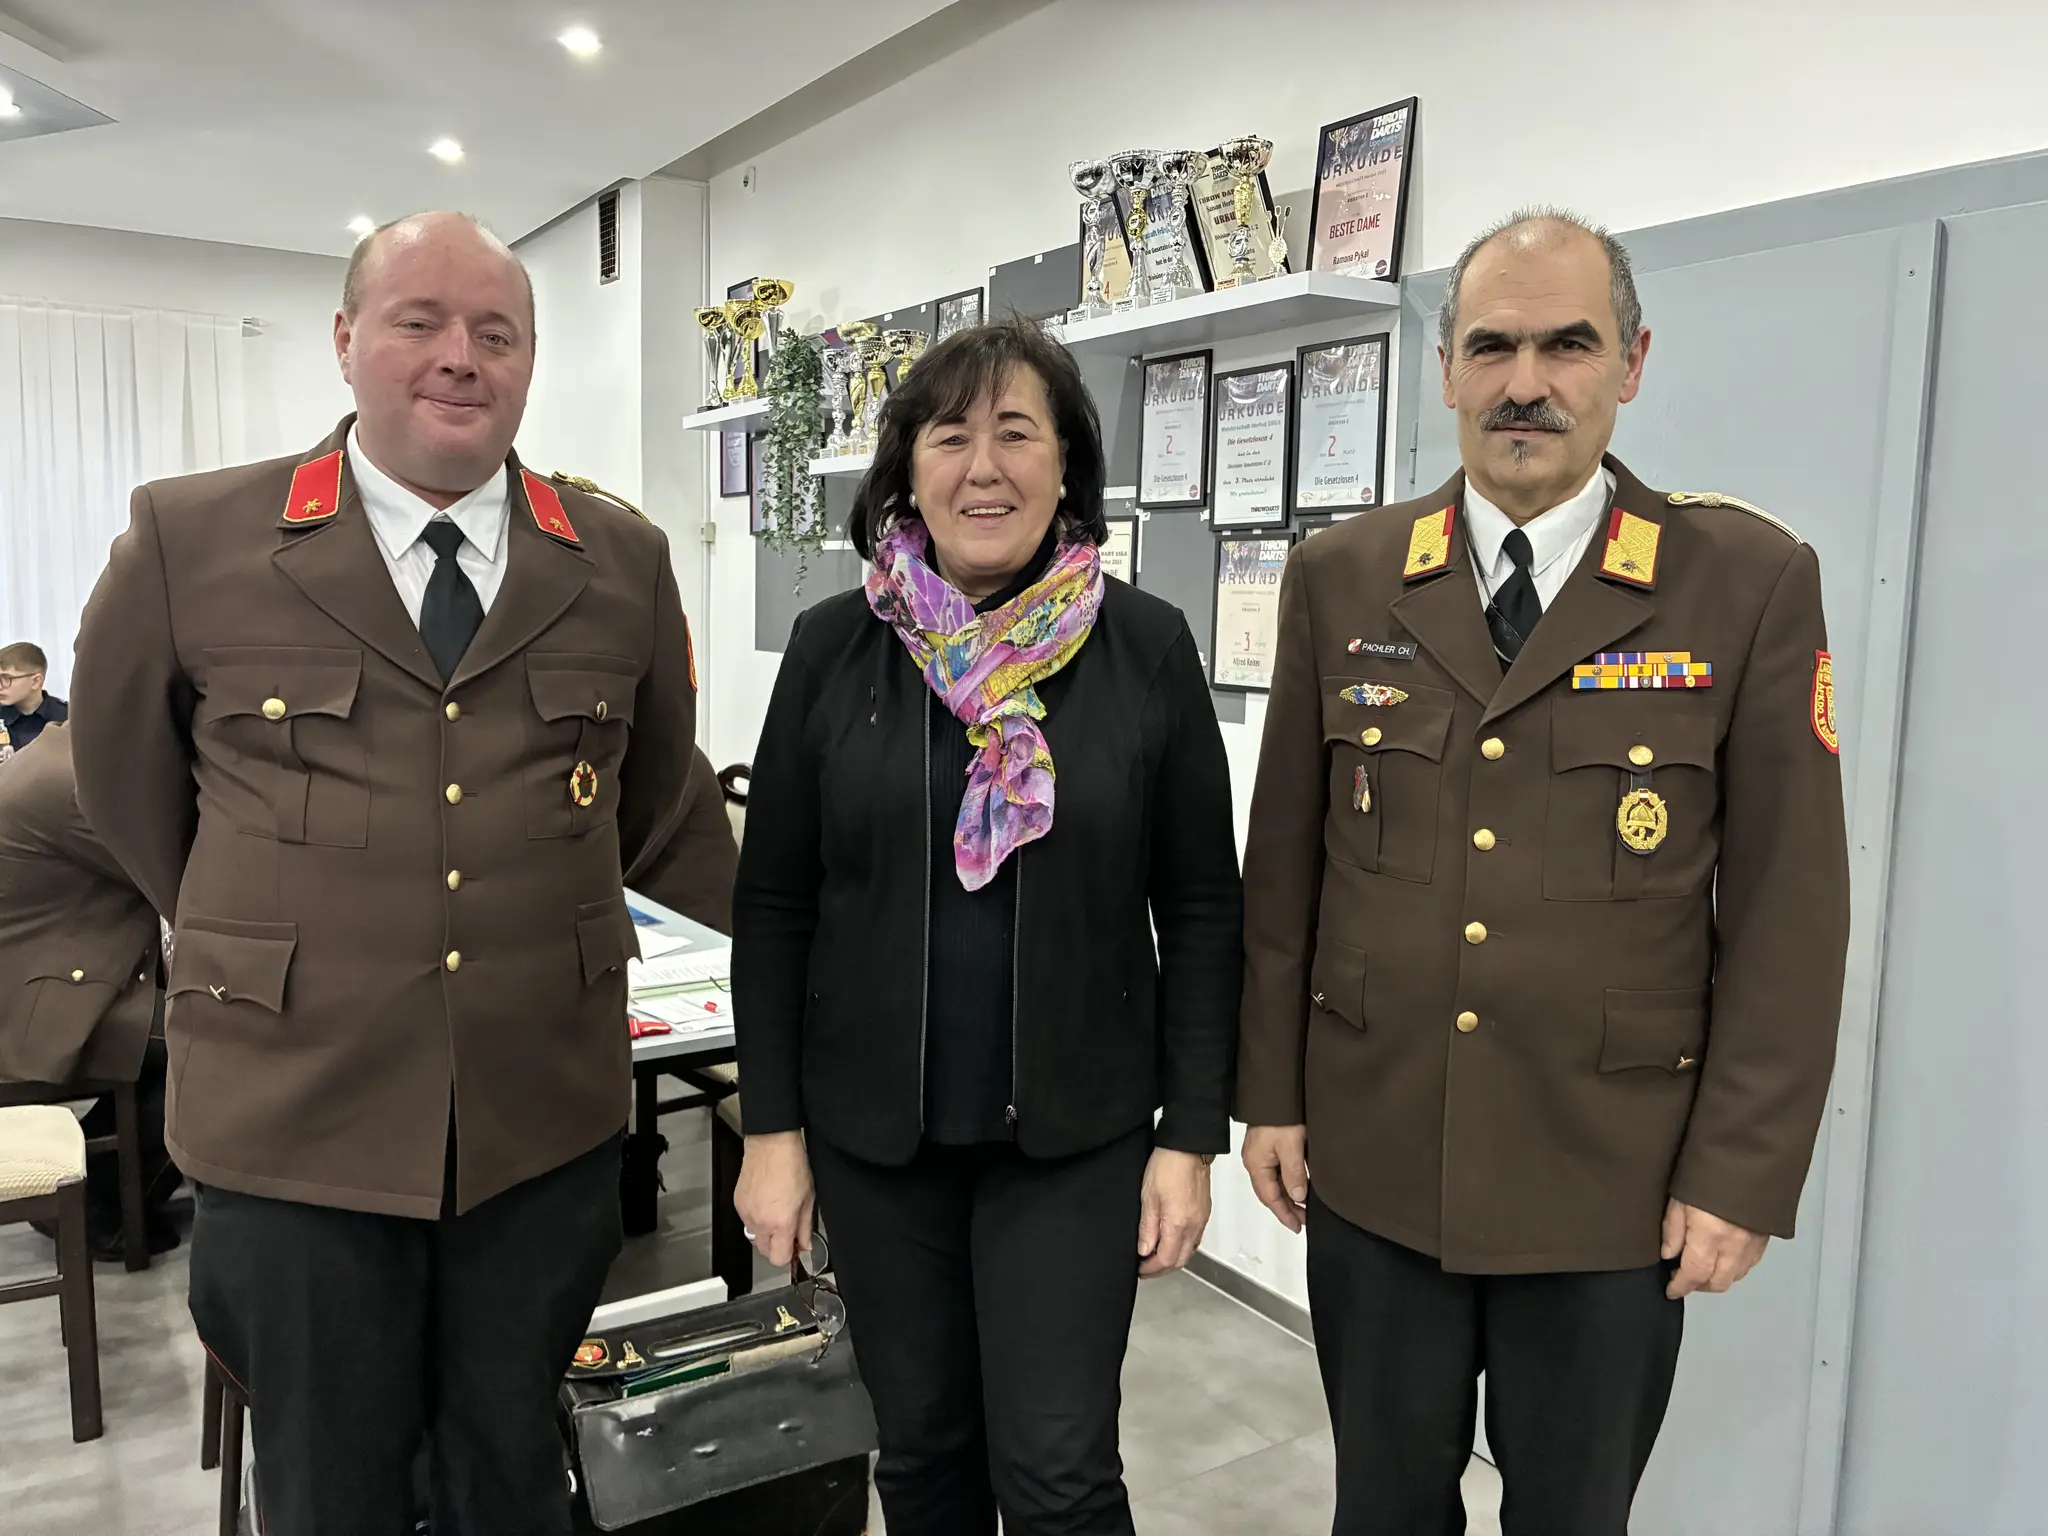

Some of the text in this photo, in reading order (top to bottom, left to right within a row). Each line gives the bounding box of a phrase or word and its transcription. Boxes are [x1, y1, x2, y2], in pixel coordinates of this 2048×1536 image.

[1372, 107, 1408, 129] THROW
[1370, 120, 1403, 140] DARTS
[1321, 144, 1403, 181] URKUNDE
[1222, 189, 1235, 198] DAR
[1329, 213, 1381, 240] BESTE DAME
[1332, 254, 1354, 267] Ramona
[1104, 280, 1110, 300] 4
[1144, 386, 1204, 407] URKUNDE
[1301, 378, 1379, 400] URKUNDE
[1219, 400, 1284, 422] URKUNDE
[1166, 435, 1173, 455] 2
[1327, 435, 1336, 458] 2
[1314, 474, 1359, 486] Die Gesetzlosen 4
[1258, 550, 1286, 561] DARTS
[1260, 540, 1289, 551] THROW
[1244, 631, 1251, 652] 3
[1361, 643, 1396, 654] PACHLER
[1232, 657, 1261, 667] Alfred Reiter
